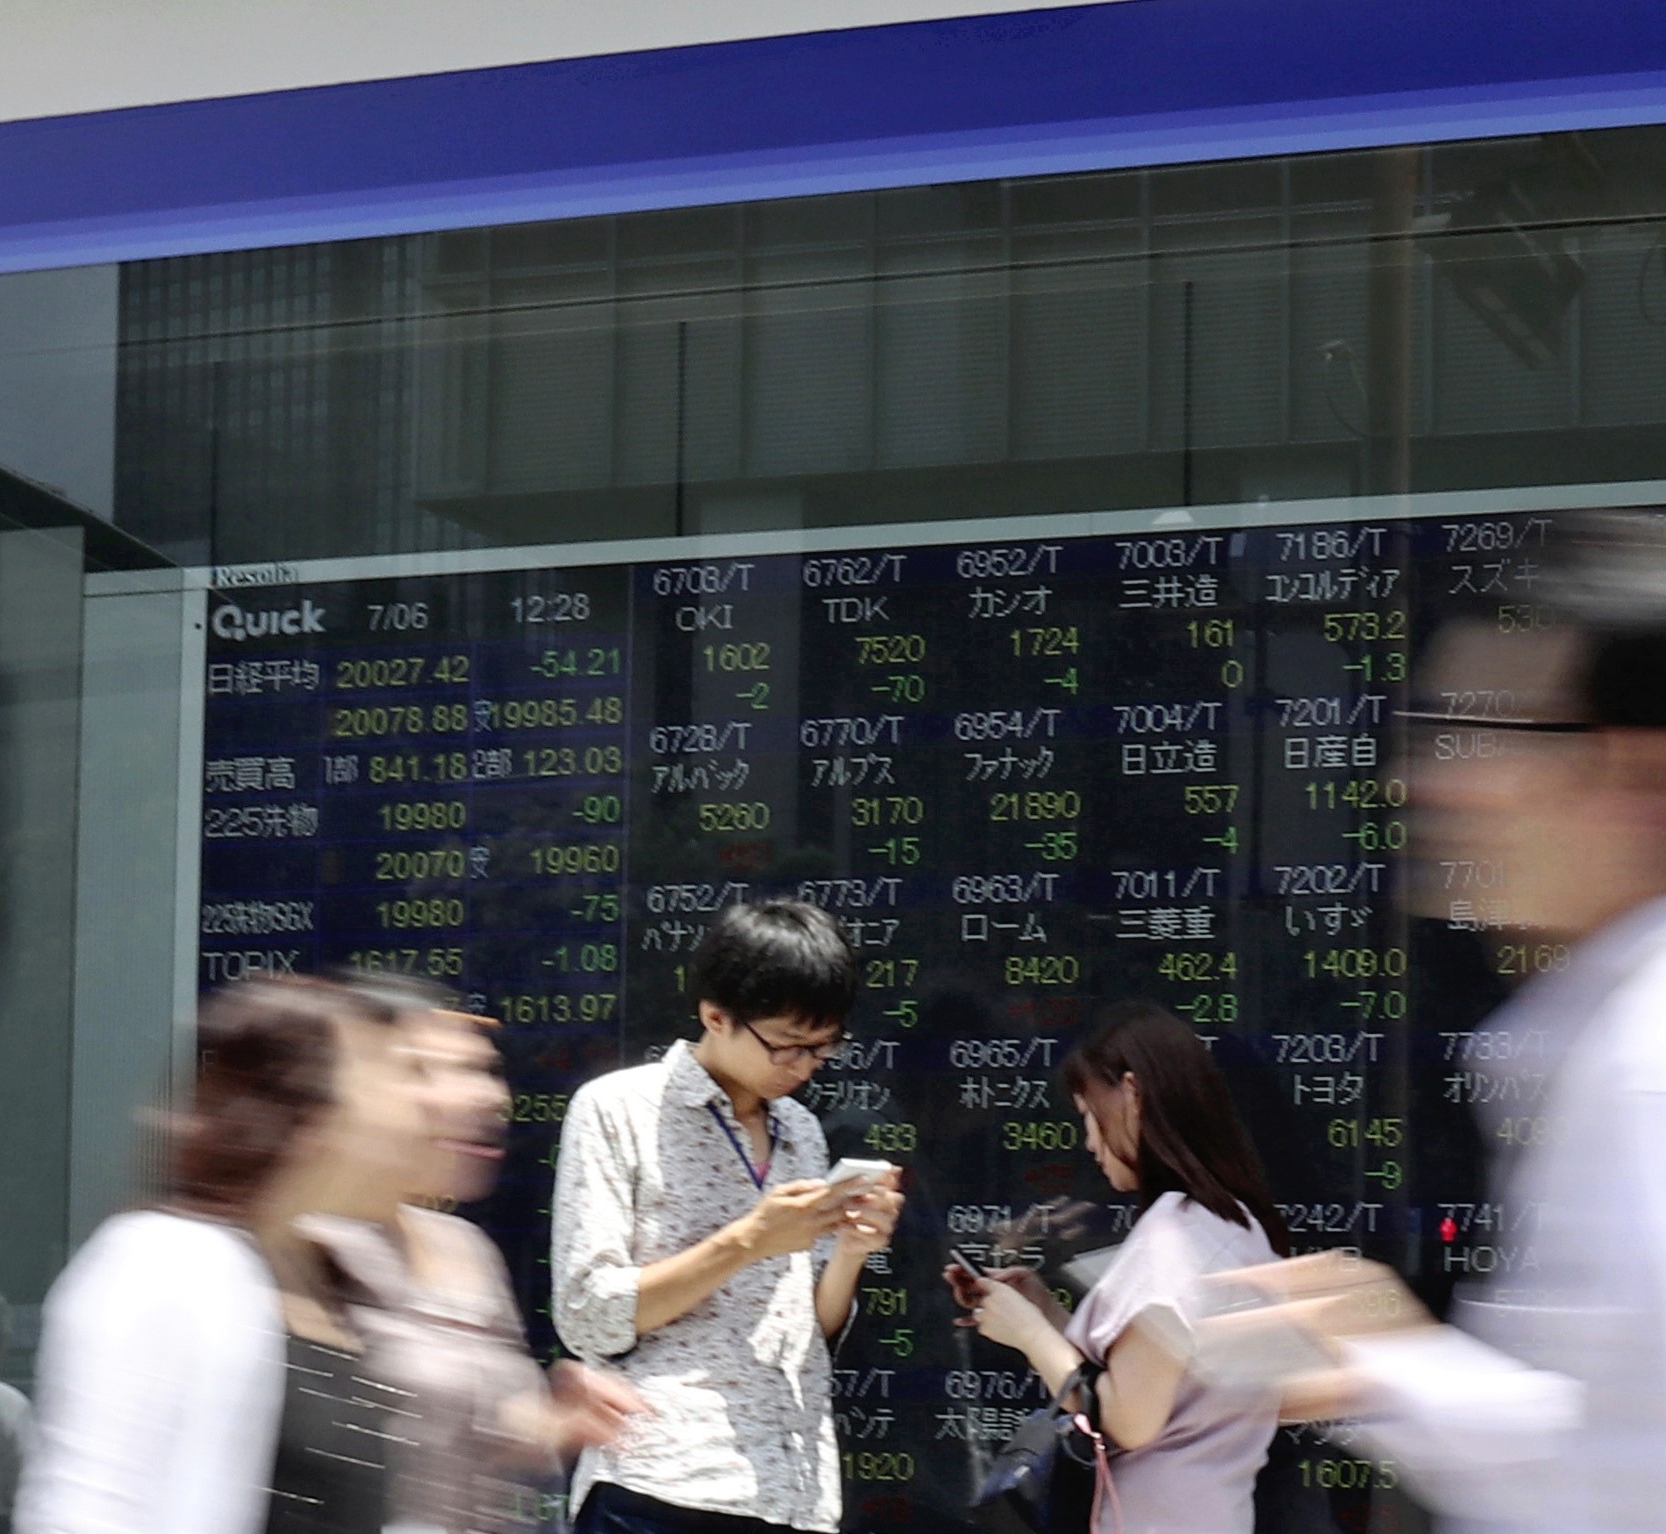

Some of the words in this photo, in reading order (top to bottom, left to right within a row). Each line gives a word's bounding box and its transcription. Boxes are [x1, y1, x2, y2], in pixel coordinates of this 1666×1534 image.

[1277, 526, 1388, 561] 7186/T
[1442, 517, 1553, 554] 7269/T
[803, 554, 907, 587] 6762/T
[957, 545, 1063, 578] 6952/T
[1449, 559, 1539, 595] スズキ
[1119, 573, 1218, 608] 三井造
[1265, 568, 1401, 602] コンコルディア
[212, 600, 327, 641] Quick
[367, 603, 429, 631] 7/06
[512, 592, 590, 623] 12:28
[823, 598, 890, 624] TDK
[968, 584, 1052, 618] カシオ
[676, 606, 732, 631] OKI
[1187, 619, 1234, 648] 161
[1324, 610, 1406, 642] 573.2
[704, 642, 770, 672] 1602
[854, 634, 926, 665] 7520
[1010, 627, 1079, 657] 1724
[209, 662, 320, 695] 日経平均
[337, 655, 470, 688] 20027.42
[530, 649, 621, 677] -54.21
[1043, 666, 1078, 695] -4
[1221, 660, 1243, 687] 0
[1342, 652, 1406, 682] -1.3
[735, 682, 769, 709] -2
[871, 674, 925, 702] -70
[335, 704, 467, 736] 20078.88
[491, 697, 622, 729] 19985.48
[1113, 700, 1223, 734] 7004/T
[1276, 693, 1388, 728] 7201/T
[1441, 690, 1517, 721] 7270
[650, 721, 752, 754] 6728/T
[800, 714, 905, 747] 6770/T
[955, 708, 1061, 741] 6954/T
[966, 745, 1054, 781] ファナック
[1122, 740, 1218, 776] 日立造
[1284, 733, 1377, 769] 日産自
[207, 756, 296, 792] 売買高
[370, 752, 467, 783] 841.18
[524, 746, 622, 776] 123.03
[651, 758, 750, 793] アルバック
[811, 753, 895, 786] アルプス
[991, 791, 1080, 821] 21890
[1185, 785, 1239, 814] 557
[1305, 779, 1406, 810] 1142.0
[205, 803, 318, 838] 225先物
[380, 802, 465, 831] 19980
[572, 796, 621, 823] -90
[699, 803, 770, 831] 5260
[851, 798, 923, 827] 3170
[868, 837, 920, 865] -15
[1025, 832, 1077, 861] -35
[1202, 826, 1238, 854] -4
[1342, 820, 1406, 851] -6.0
[375, 851, 465, 880] 20070
[532, 846, 619, 874] 19960
[1440, 861, 1507, 890] 7701
[953, 871, 1059, 904] 6963/T
[1112, 867, 1222, 899] 7011/T
[1273, 862, 1386, 896] 7202/T
[377, 900, 464, 928] 19980
[570, 894, 619, 922] -75
[647, 881, 749, 912] 6752/T
[962, 912, 1047, 943] ローム
[1115, 906, 1215, 941] 三菱重
[1447, 898, 1547, 933] 島津
[202, 951, 300, 981] TOPIX
[542, 944, 618, 972] -1.08
[866, 958, 918, 988] 217
[1005, 956, 1080, 985] 8420
[1158, 952, 1238, 981] 462.4
[502, 994, 616, 1024] 1613.97
[883, 1000, 918, 1027] -5
[949, 1037, 1059, 1068] 6965/T
[959, 1076, 1050, 1109] ホトニクス
[1294, 1071, 1365, 1105] トヨタ
[864, 1123, 917, 1152] 433
[1003, 1122, 1077, 1150] 3460
[1328, 1118, 1403, 1148] 6145
[1364, 1160, 1403, 1190] -9
[1443, 1247, 1540, 1272] HOYA
[878, 1331, 913, 1356] -5
[843, 1453, 914, 1481] 1920
[1298, 1460, 1398, 1489] 1607.5
